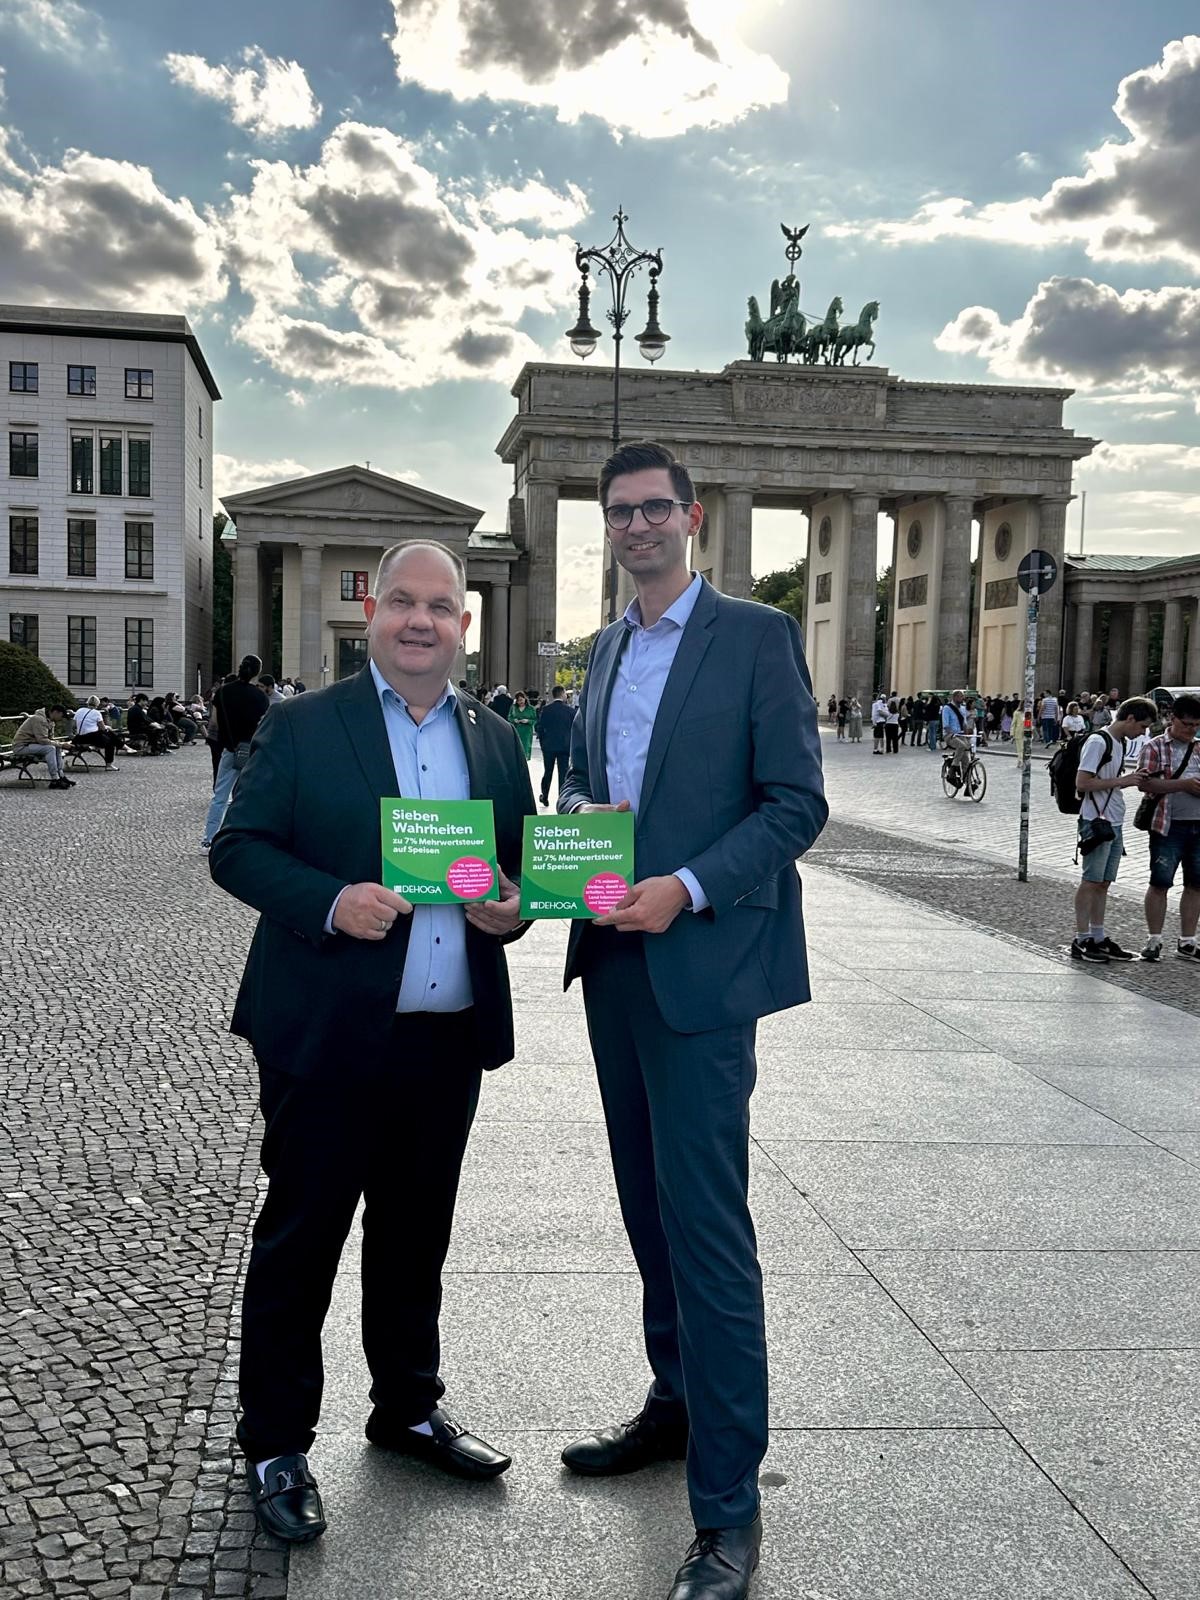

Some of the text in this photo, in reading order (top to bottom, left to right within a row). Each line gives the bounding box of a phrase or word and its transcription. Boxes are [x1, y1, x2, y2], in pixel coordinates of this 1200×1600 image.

[392, 809, 439, 822] Sieben
[392, 822, 473, 834] Wahrheiten
[534, 826, 580, 837] Sieben
[534, 838, 612, 850] Wahrheiten
[408, 846, 440, 854] Speisen
[558, 854, 623, 862] Mehrwertsteuer
[547, 863, 578, 871] Speisen
[402, 885, 442, 894] DEHOGA
[538, 902, 578, 910] DEHOGA
